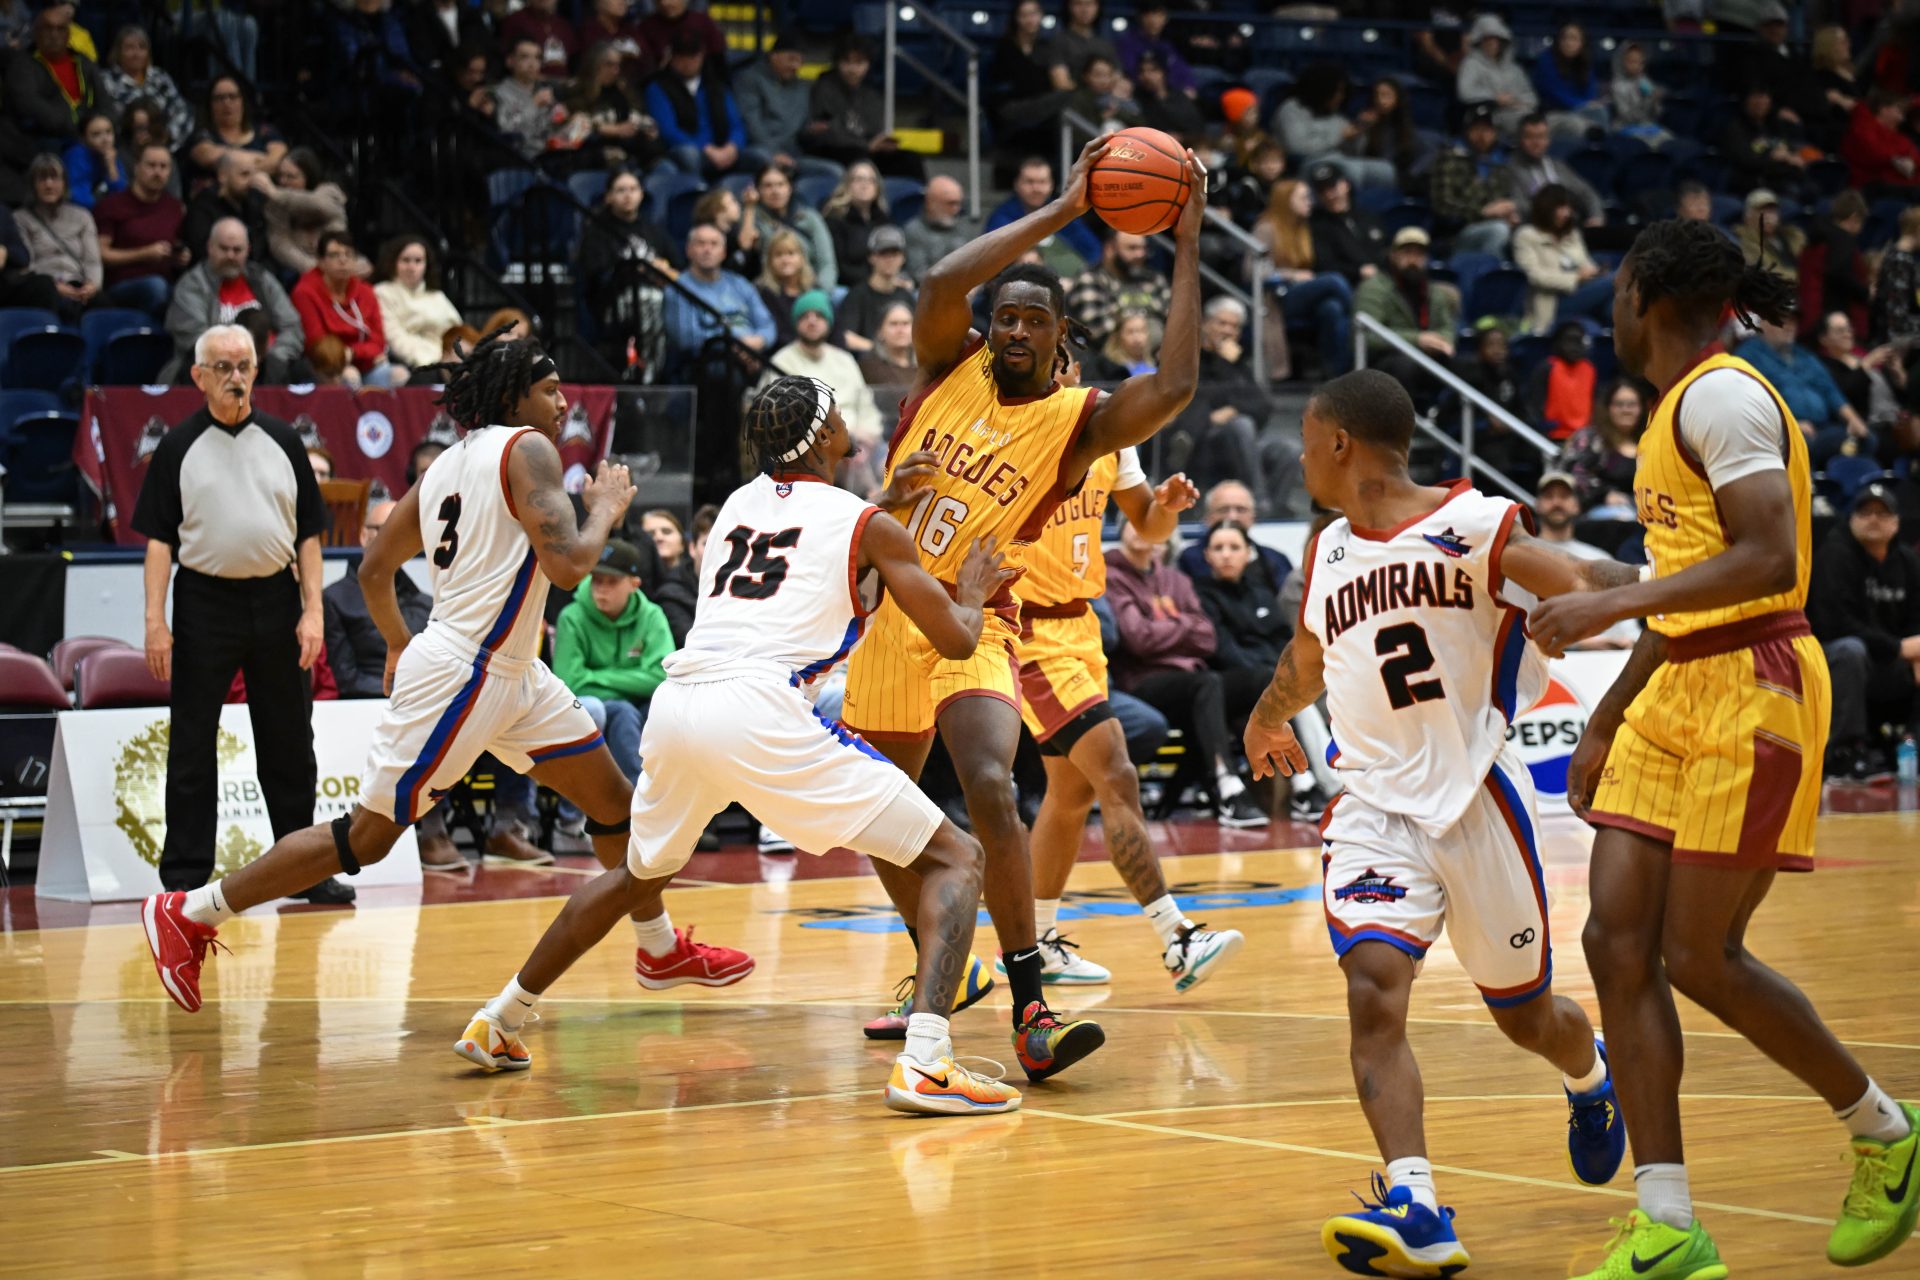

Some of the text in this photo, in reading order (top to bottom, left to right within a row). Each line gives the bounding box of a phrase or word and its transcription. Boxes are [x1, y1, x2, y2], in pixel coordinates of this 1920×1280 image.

[920, 428, 1030, 507] ROGUES
[433, 492, 462, 570] 3
[708, 525, 803, 600] 15
[906, 489, 969, 558] 16
[1072, 532, 1091, 581] 9
[1325, 561, 1474, 646] ADMIRALS
[1374, 621, 1446, 711] 2
